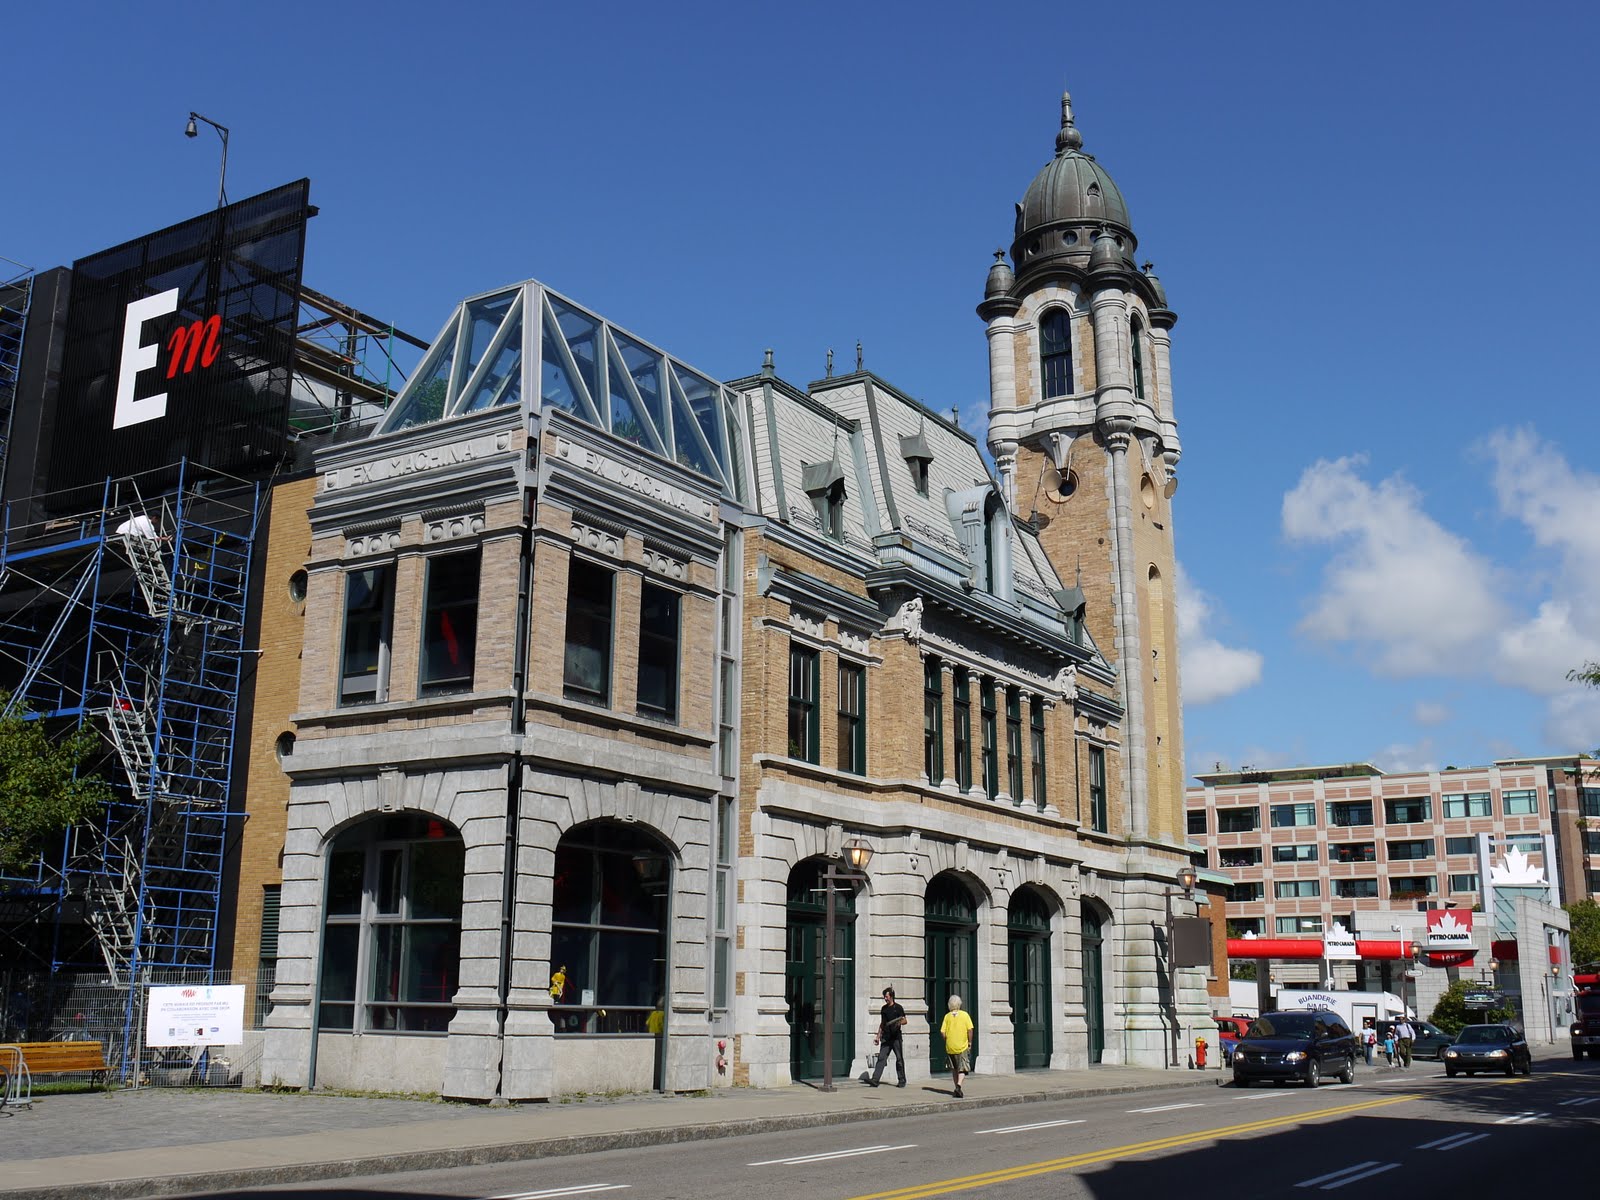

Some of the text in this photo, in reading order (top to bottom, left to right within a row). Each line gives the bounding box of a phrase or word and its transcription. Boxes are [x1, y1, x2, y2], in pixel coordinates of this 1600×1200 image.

[350, 443, 478, 485] EX MACHINA
[584, 452, 690, 513] EX MACHINA
[1297, 994, 1337, 1006] BUANDERIE
